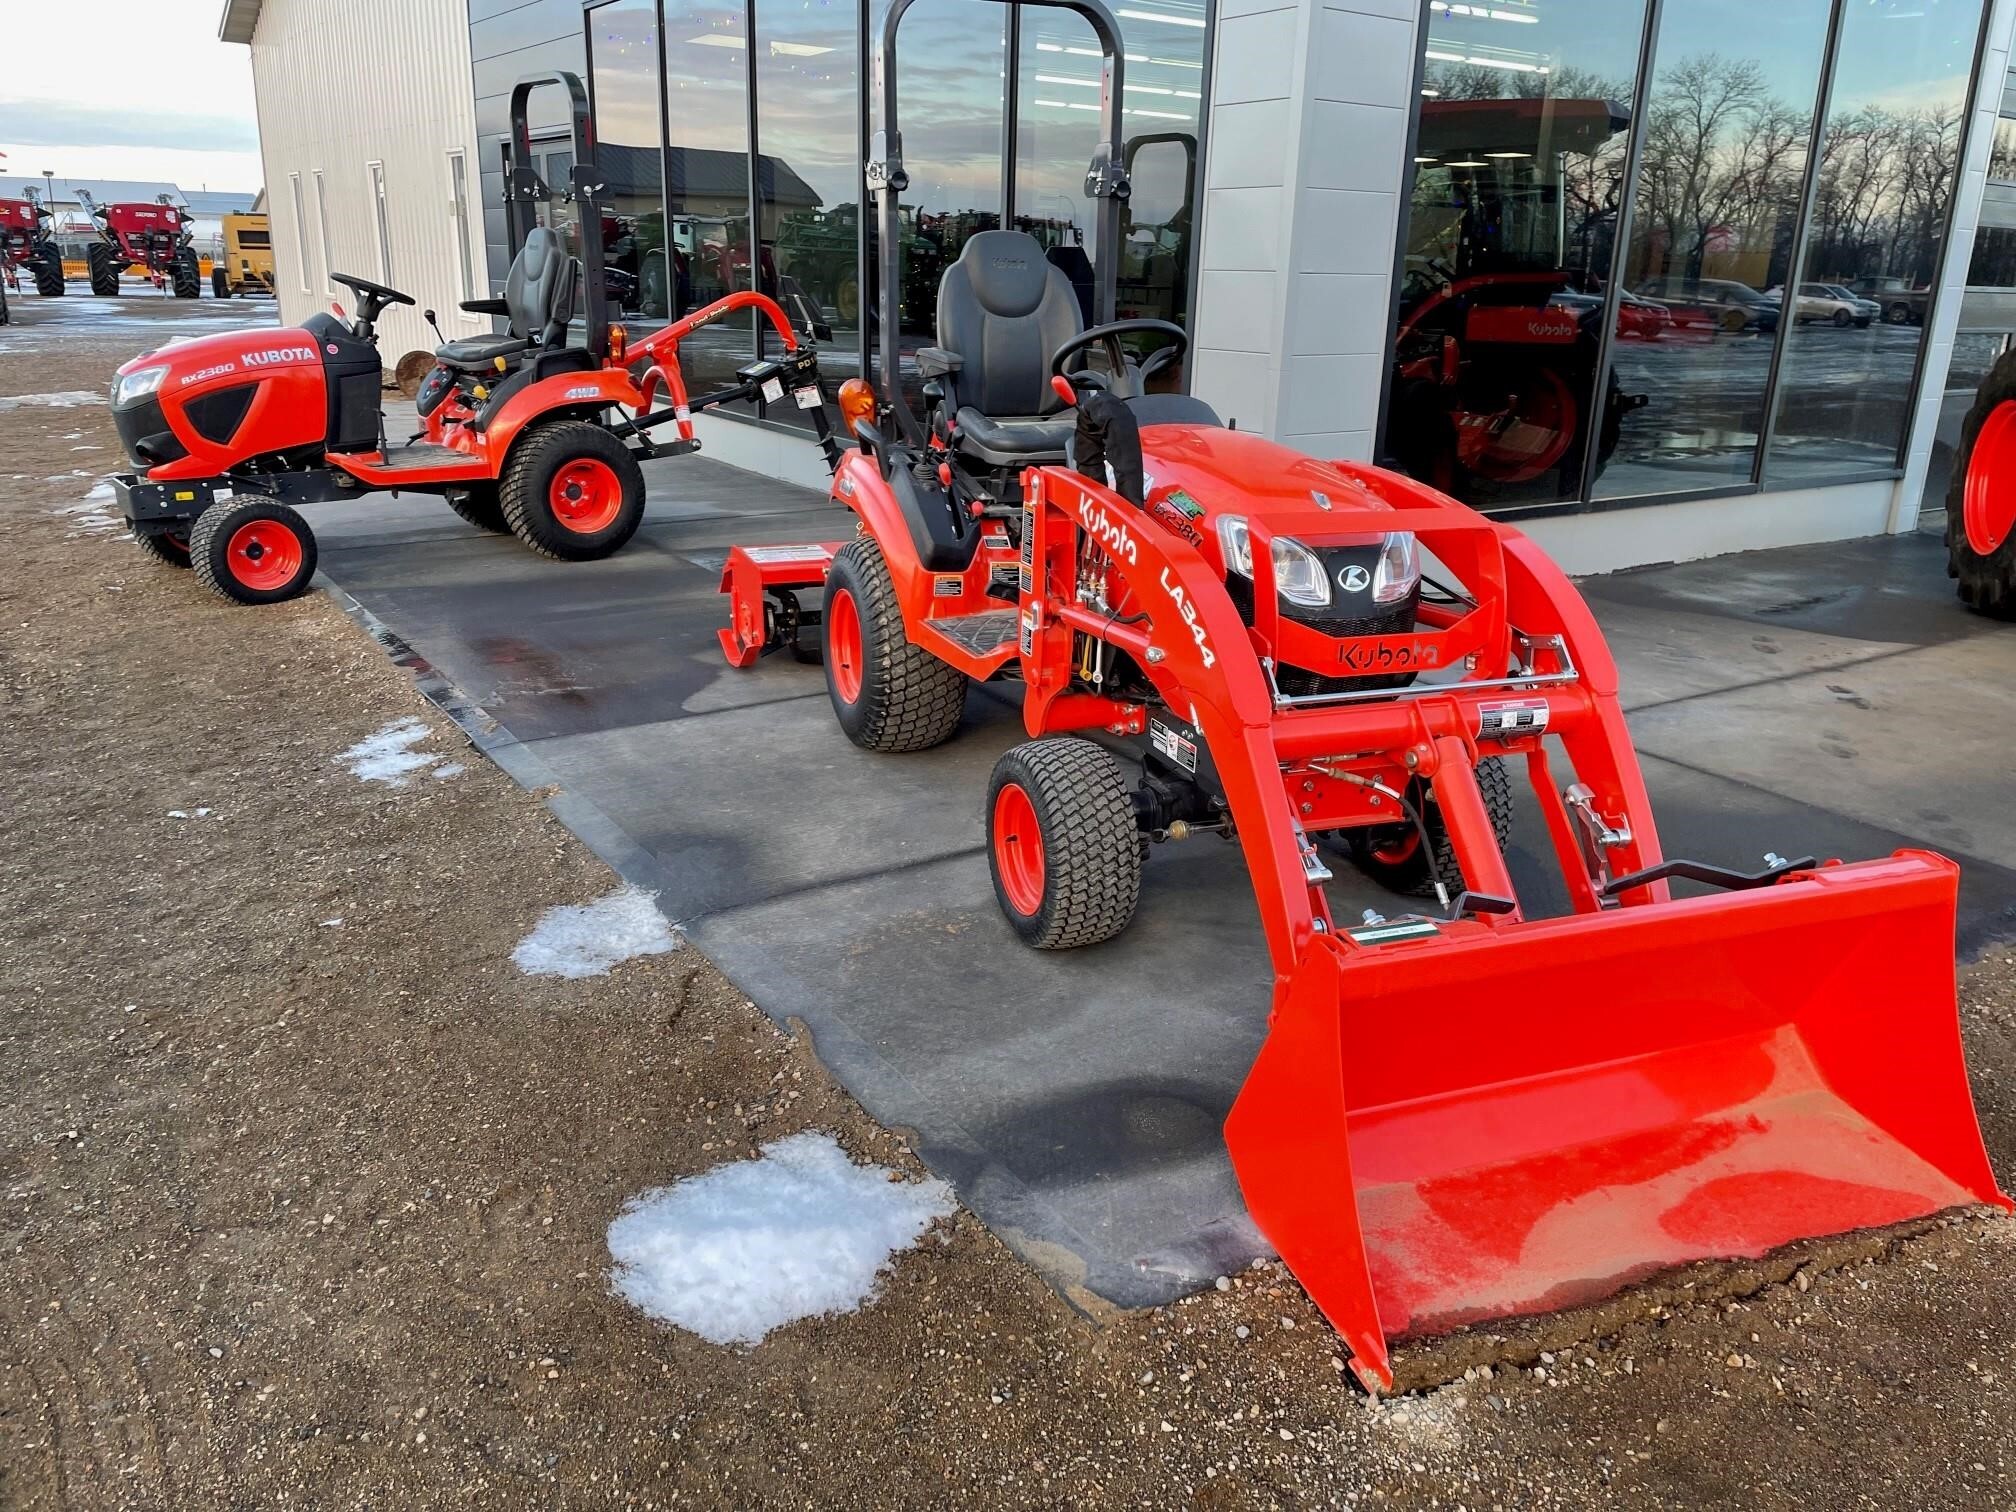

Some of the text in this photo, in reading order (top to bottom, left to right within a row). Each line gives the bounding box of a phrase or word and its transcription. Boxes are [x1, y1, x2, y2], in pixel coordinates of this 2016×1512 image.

[1528, 322, 1572, 336] Kubota
[241, 347, 316, 367] KUBOTA
[181, 363, 235, 385] BX2380
[565, 386, 599, 398] 4WD
[1079, 492, 1137, 566] Kubota
[1160, 566, 1216, 669] LA344
[1338, 640, 1438, 669] Kubota
